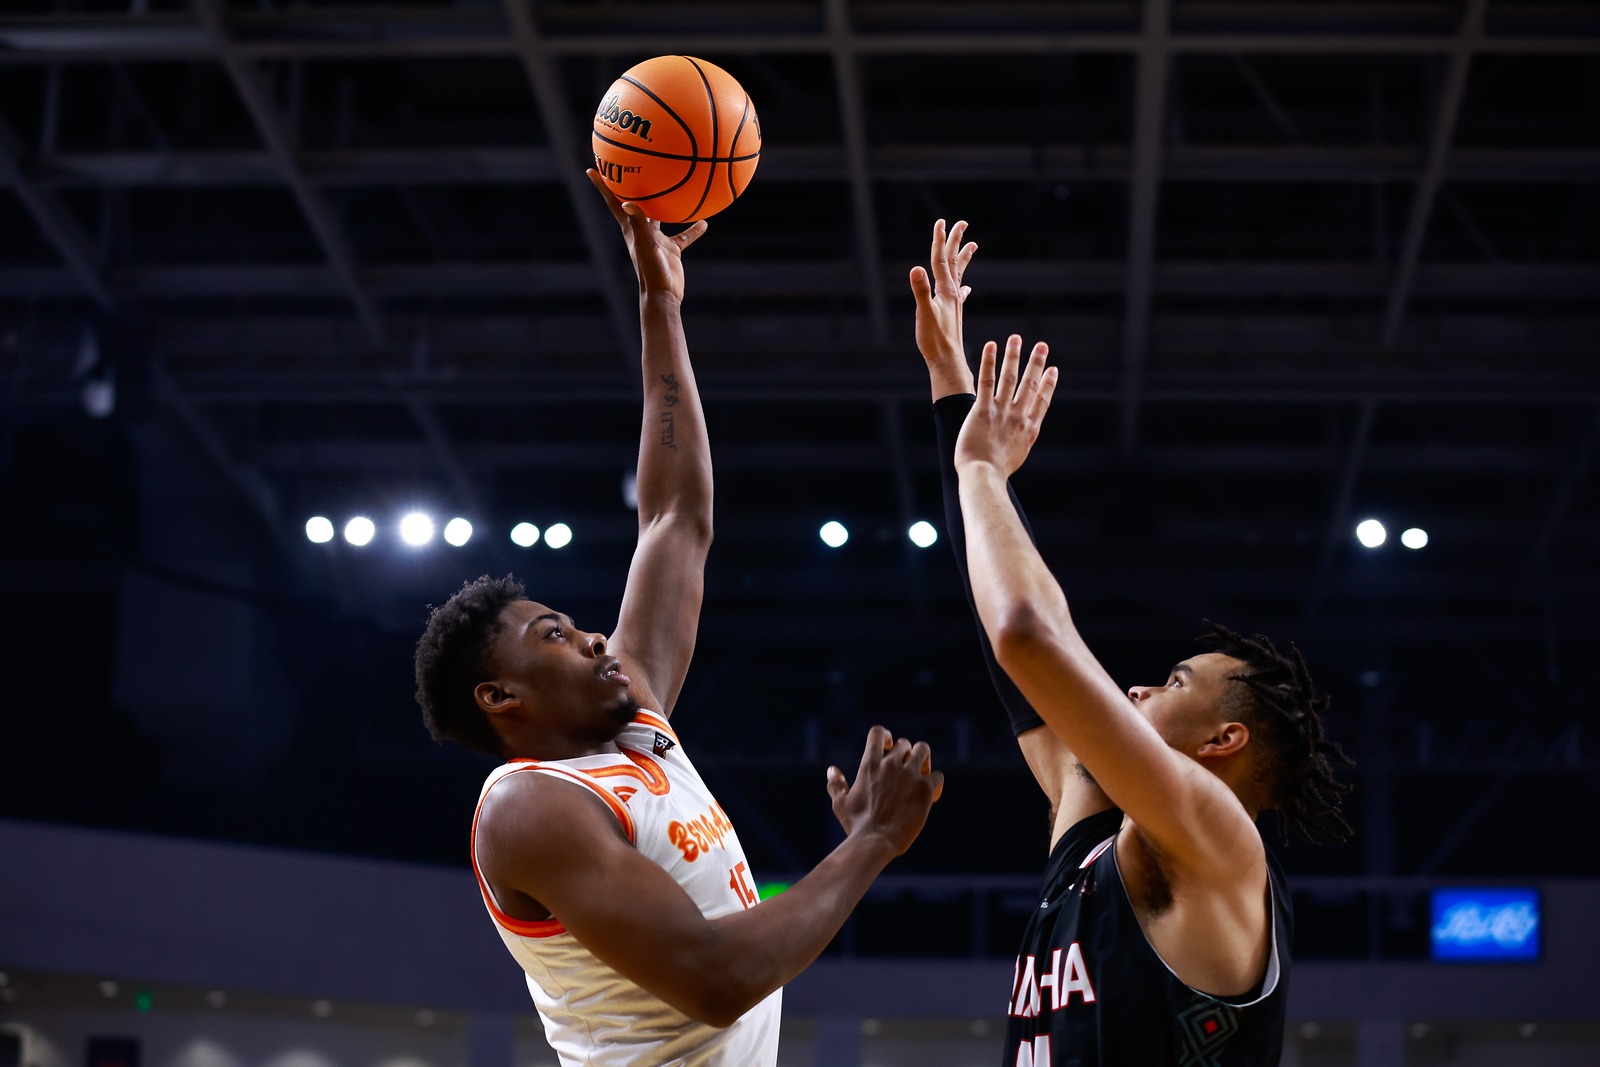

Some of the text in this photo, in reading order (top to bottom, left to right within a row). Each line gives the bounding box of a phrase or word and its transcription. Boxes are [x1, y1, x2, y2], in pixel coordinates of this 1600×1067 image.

[597, 92, 652, 141] ilson
[729, 861, 759, 910] 15
[1008, 940, 1097, 1018] AHA
